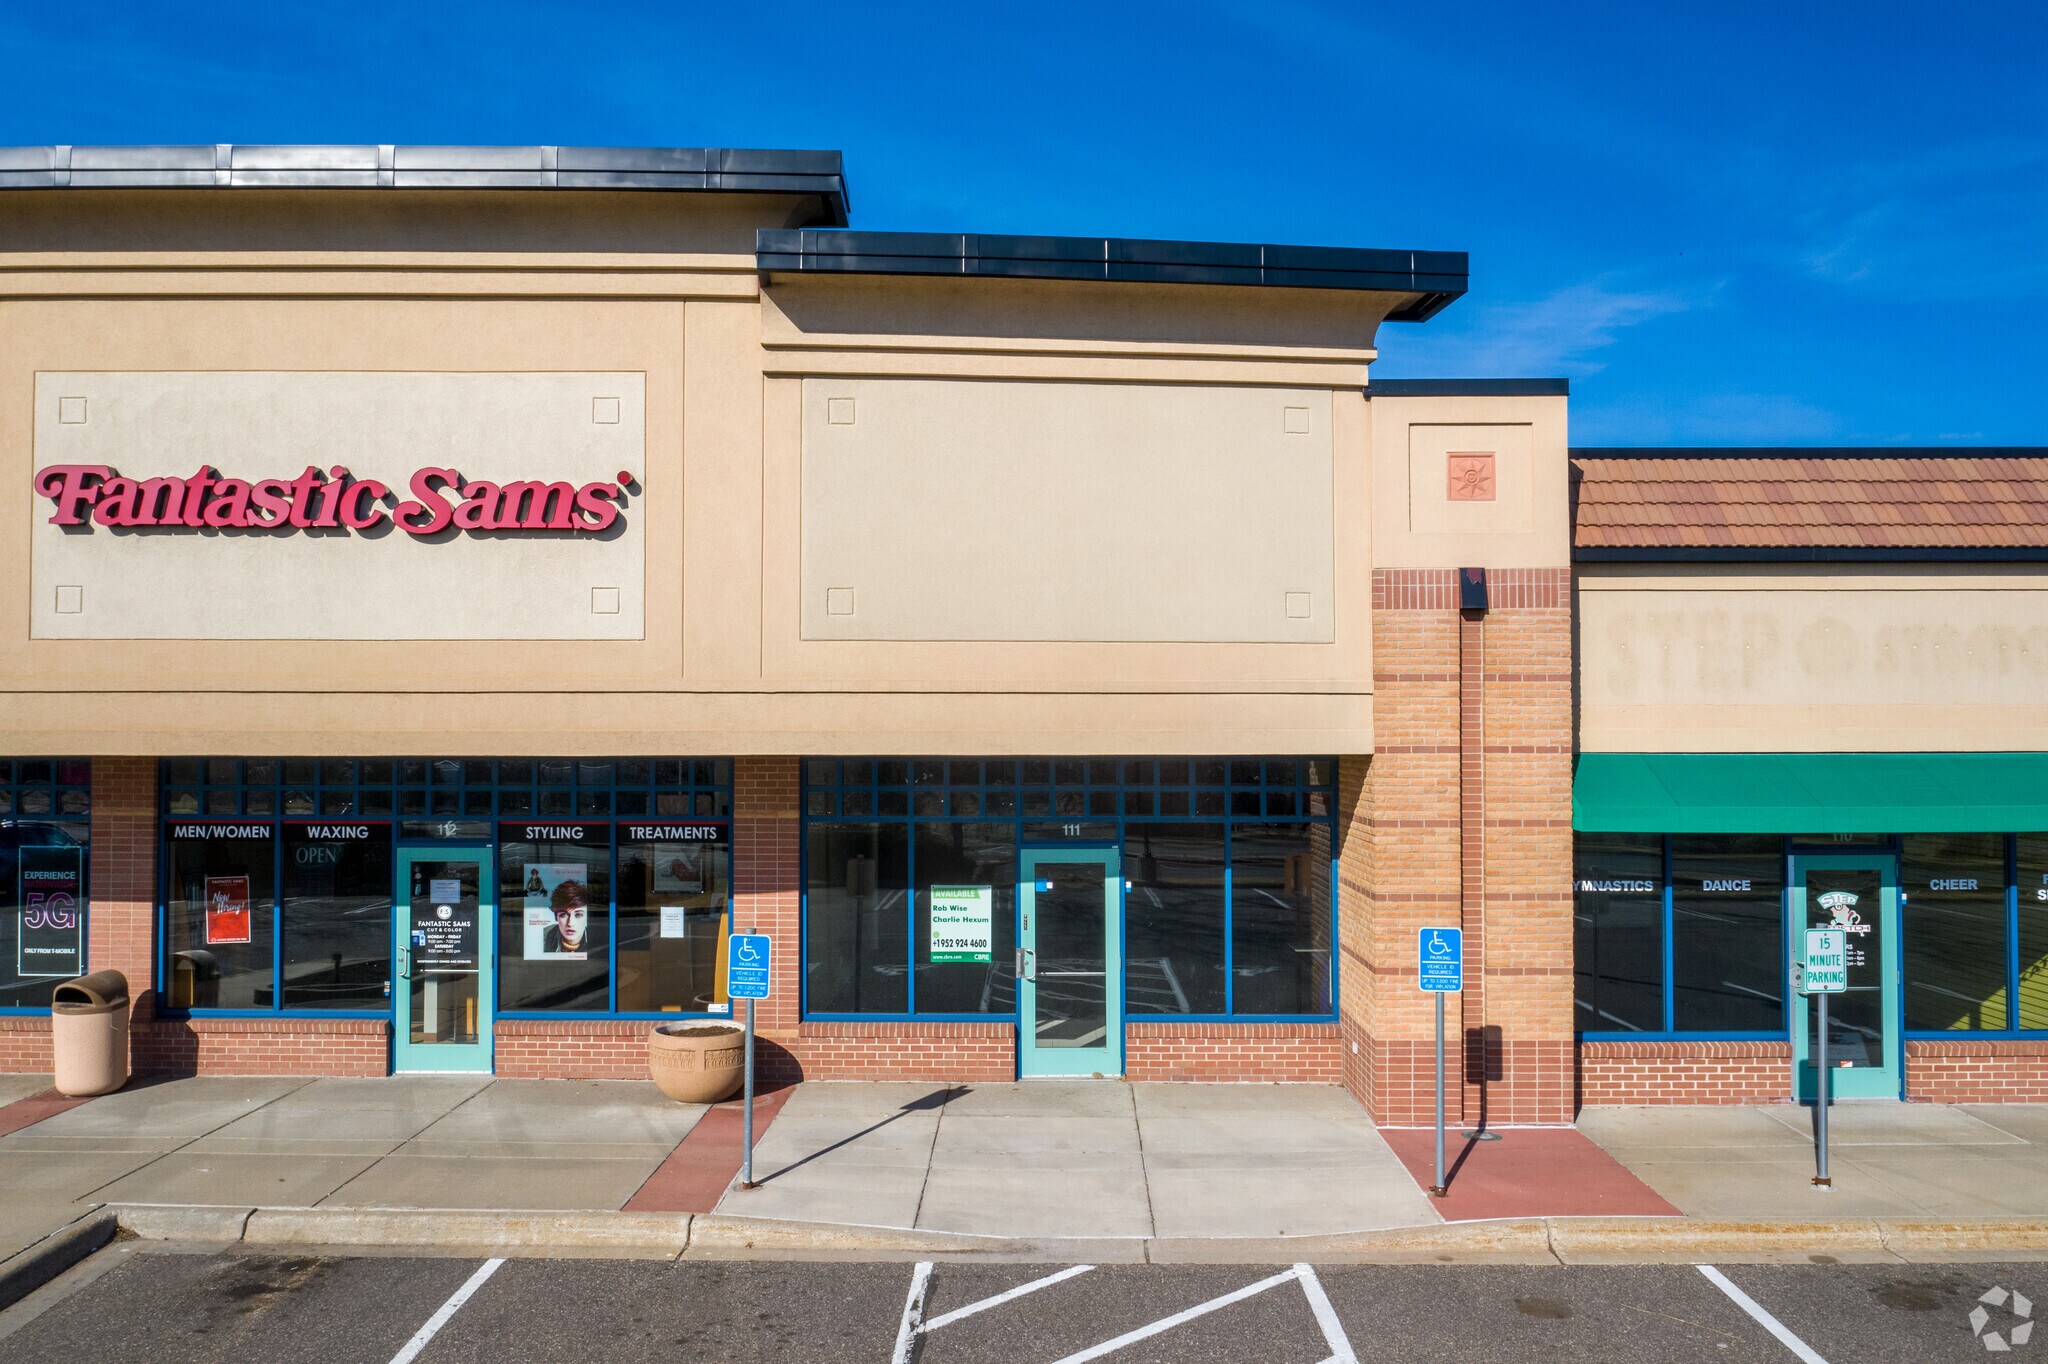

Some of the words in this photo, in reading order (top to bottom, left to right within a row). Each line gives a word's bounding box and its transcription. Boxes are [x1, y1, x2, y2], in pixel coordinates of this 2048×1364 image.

[34, 464, 388, 530] Fantastic
[174, 825, 270, 839] MEN/WOMEN
[307, 825, 369, 839] WAXING
[526, 826, 584, 839] STYLING
[630, 826, 717, 839] TREATMENTS
[1062, 824, 1081, 836] 111
[296, 847, 337, 863] OPEN
[24, 871, 76, 880] EXPERIENCE
[1573, 880, 1653, 891] YMNASTICS
[1703, 880, 1751, 891] DANCE
[1930, 879, 1978, 890] CHEER
[212, 891, 230, 904] Now
[1820, 893, 1857, 909] STEP
[24, 892, 76, 929] 5G
[956, 939, 968, 948] 924
[970, 939, 987, 948] 4600
[1820, 938, 1830, 949] 15
[1810, 954, 1840, 966] MINUTE
[1808, 971, 1843, 983] PARKING
